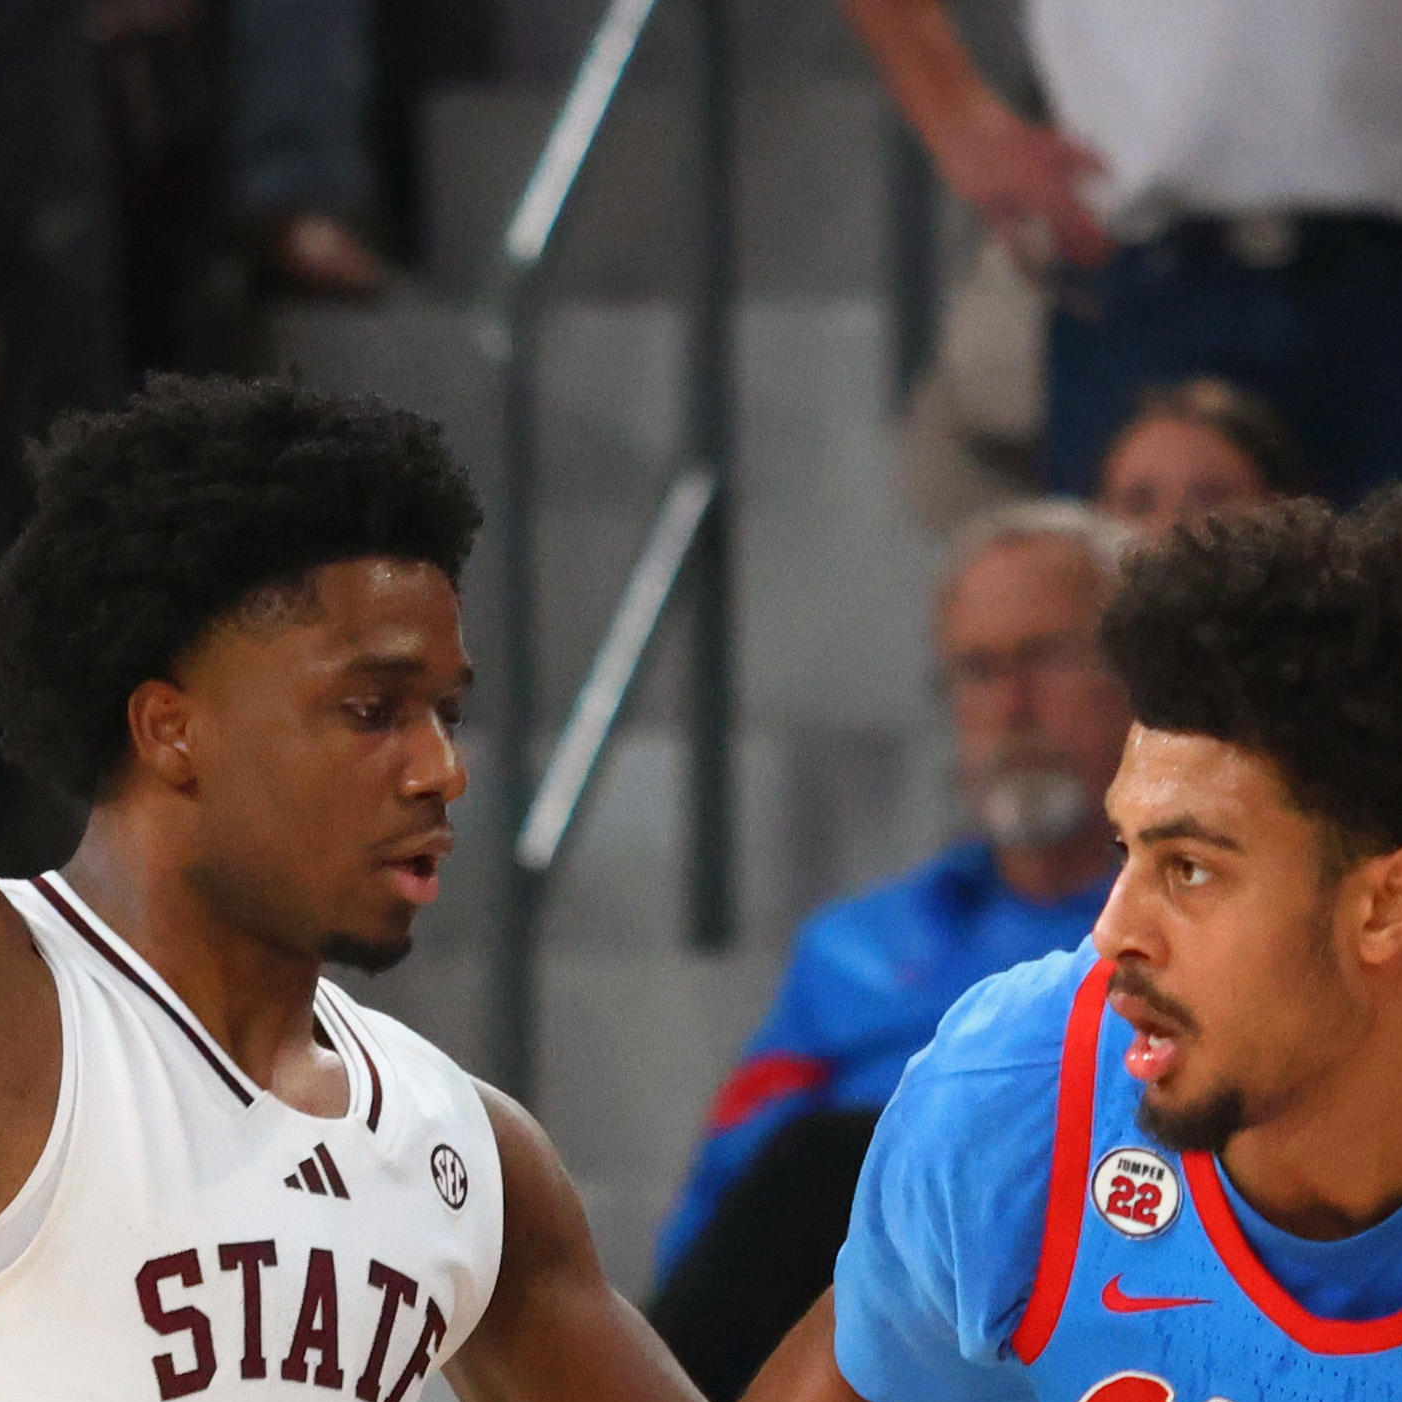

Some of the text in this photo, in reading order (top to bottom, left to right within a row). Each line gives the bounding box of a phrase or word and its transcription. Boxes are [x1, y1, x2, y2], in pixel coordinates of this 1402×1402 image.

[434, 1149, 465, 1204] SEC
[1117, 1157, 1165, 1181] JUMPER
[1106, 1175, 1162, 1227] 22
